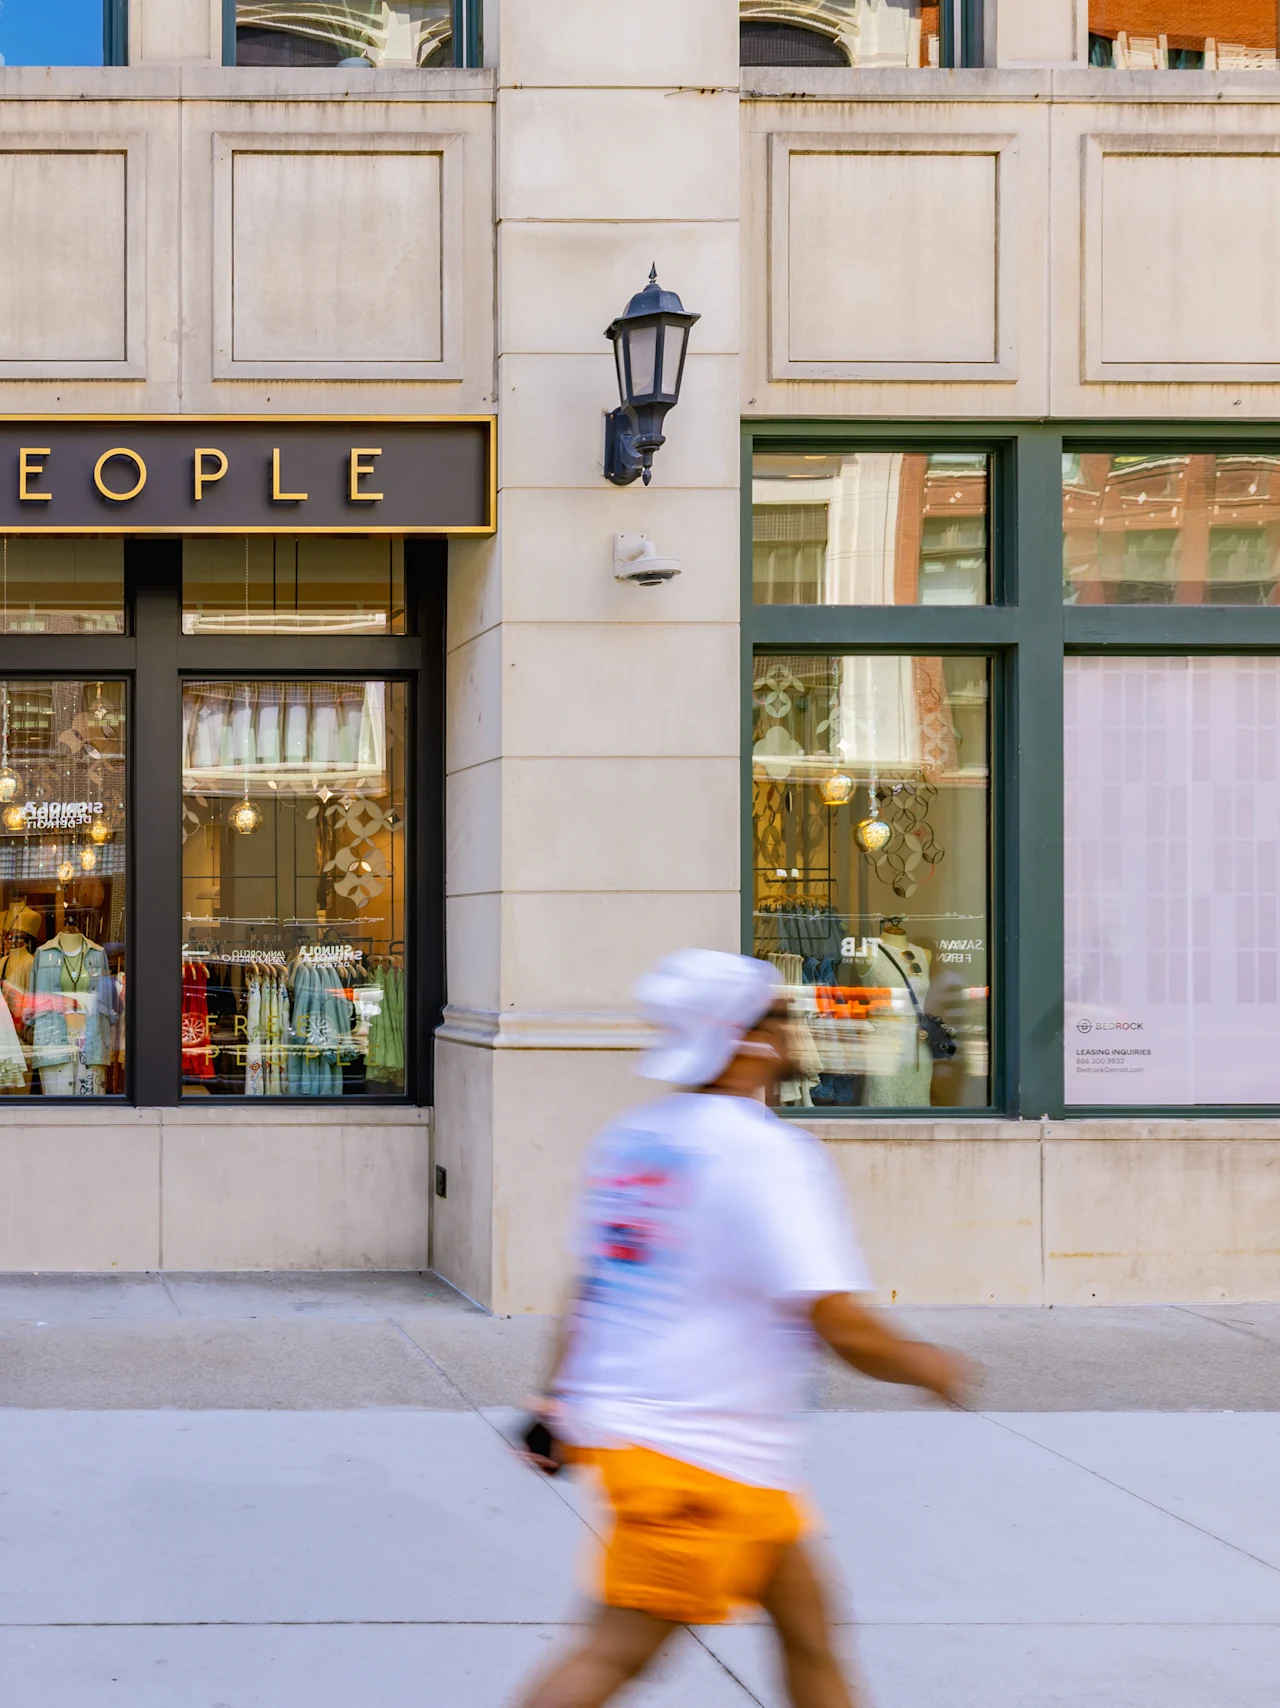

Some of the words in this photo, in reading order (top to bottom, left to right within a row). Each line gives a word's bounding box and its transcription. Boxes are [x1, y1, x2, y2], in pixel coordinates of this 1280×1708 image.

[205, 1015, 311, 1037] FREE
[1095, 1022, 1144, 1031] BEDROCK
[205, 1045, 381, 1067] PEOPLE
